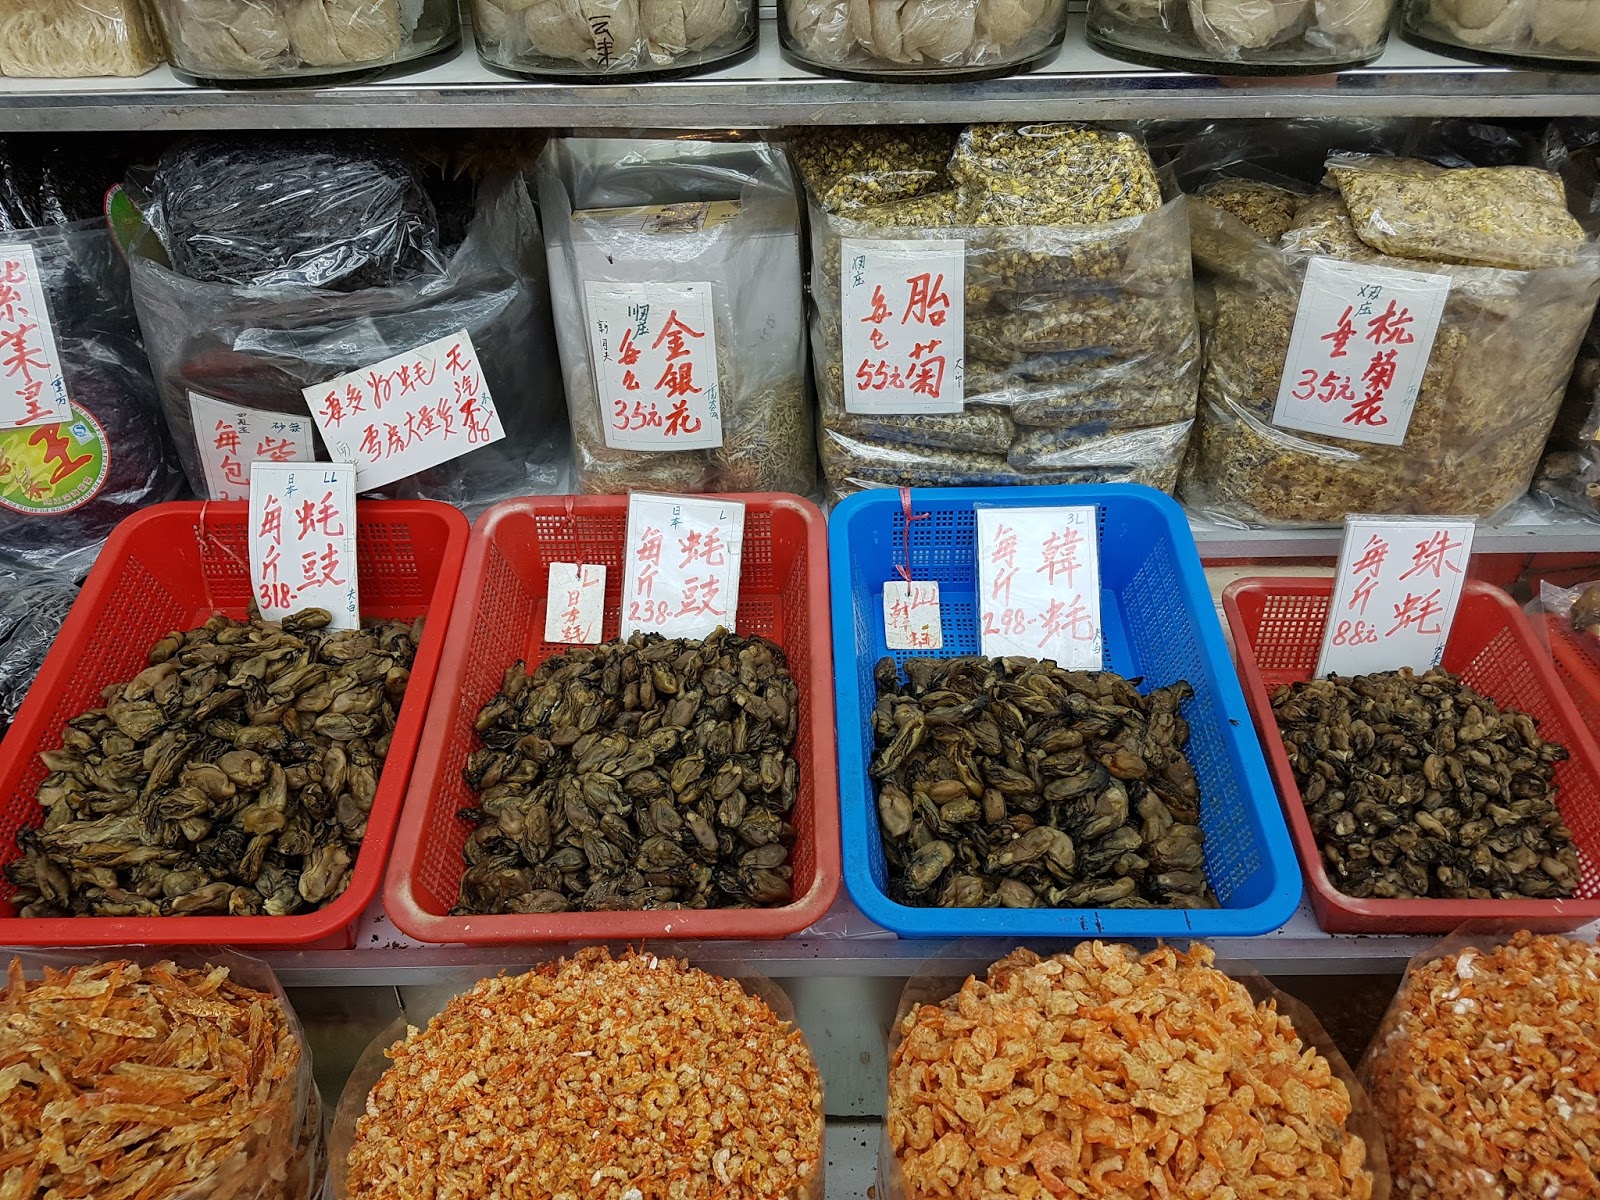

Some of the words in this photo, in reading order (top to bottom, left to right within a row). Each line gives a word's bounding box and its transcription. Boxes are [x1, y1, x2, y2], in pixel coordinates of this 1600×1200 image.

[901, 272, 950, 399] 胎菊
[283, 474, 298, 498] 日本
[323, 472, 338, 484] LL
[259, 494, 283, 582] 每斤
[670, 506, 683, 530] 日本
[719, 510, 727, 520] L
[1067, 513, 1084, 525] 3L
[636, 526, 664, 598] 每斤
[991, 523, 1020, 607] 每斤
[1348, 534, 1389, 616] 每斤
